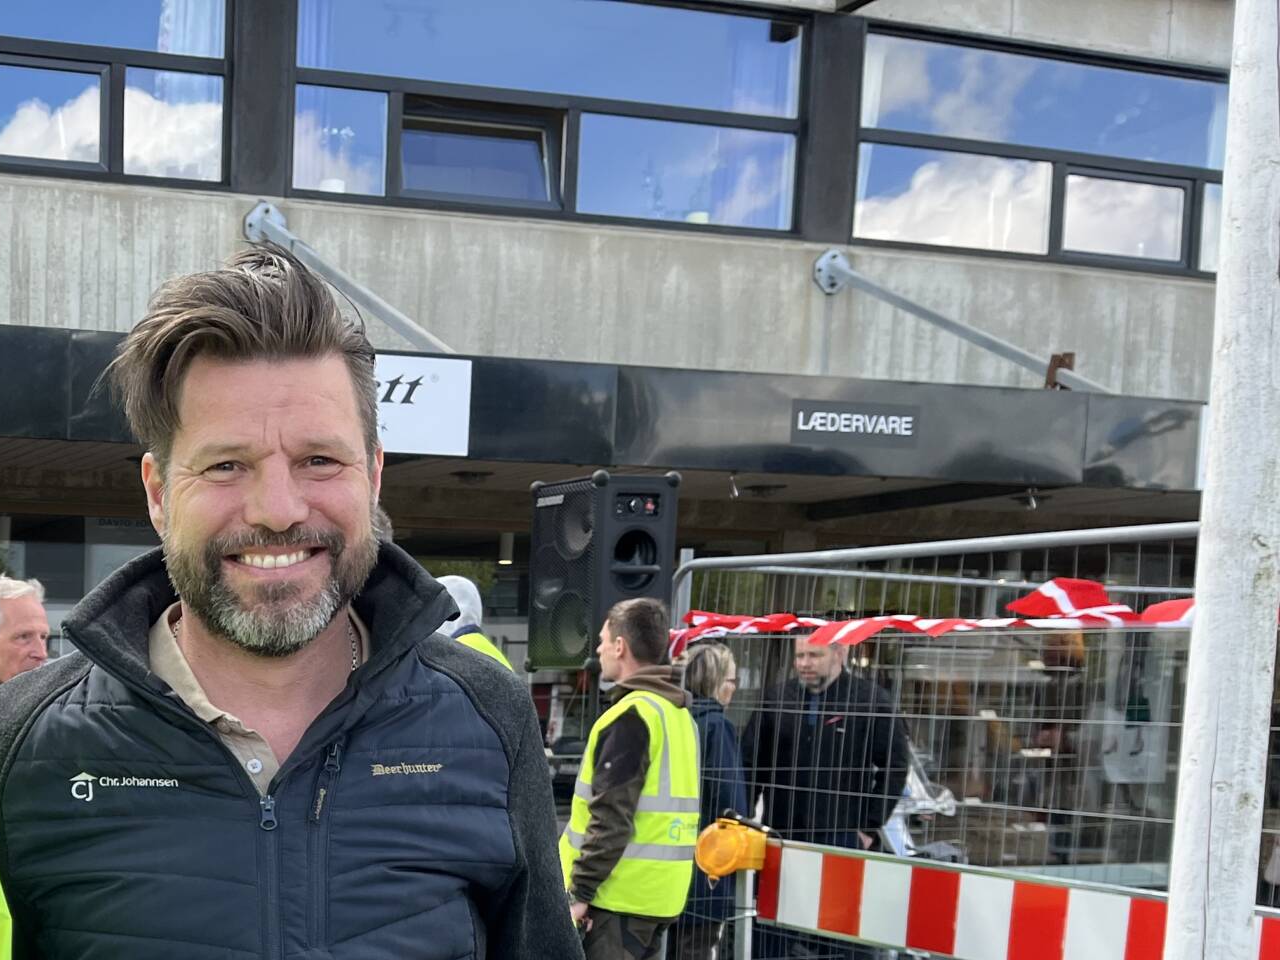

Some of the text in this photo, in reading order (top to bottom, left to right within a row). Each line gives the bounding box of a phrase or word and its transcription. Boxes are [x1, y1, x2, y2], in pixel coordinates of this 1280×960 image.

[375, 374, 424, 405] tt
[797, 411, 913, 436] LÆDERVARE
[370, 762, 442, 776] Deerhunter
